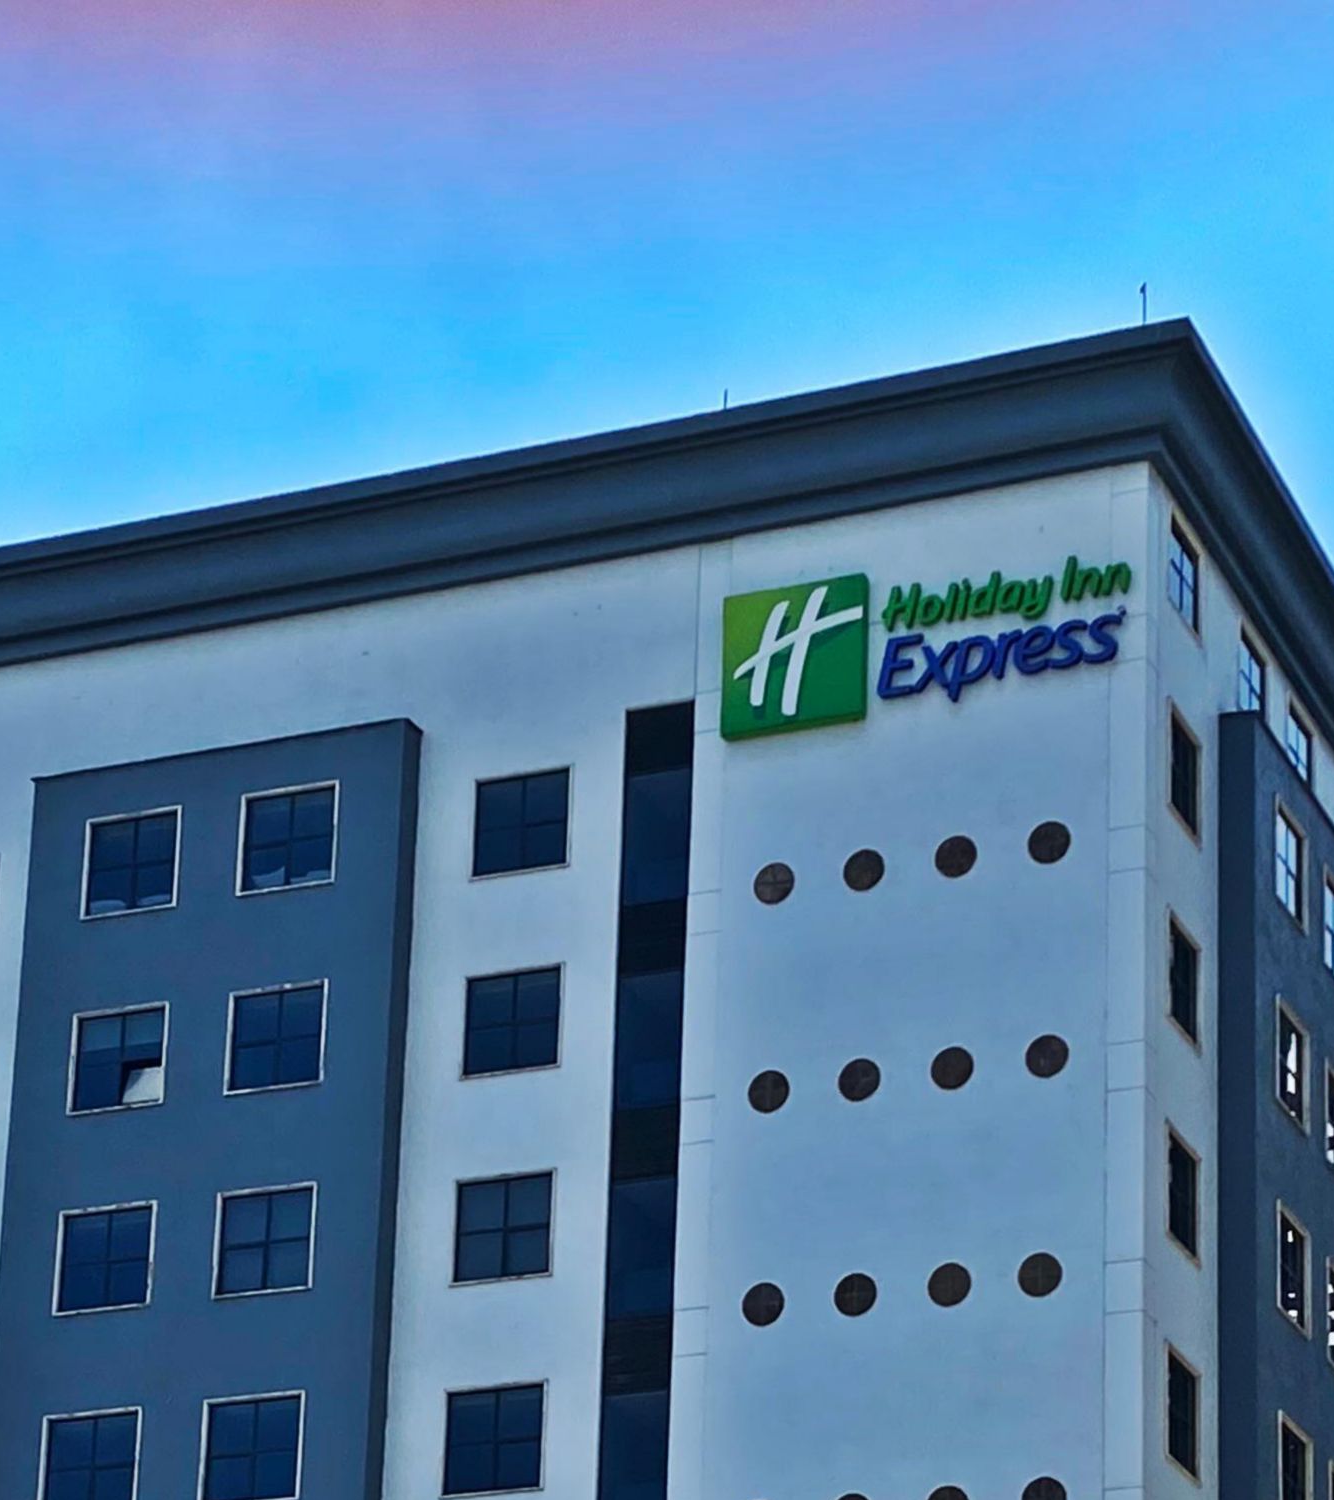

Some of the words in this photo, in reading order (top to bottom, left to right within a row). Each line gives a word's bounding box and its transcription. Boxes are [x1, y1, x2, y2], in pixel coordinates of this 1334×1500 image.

[881, 571, 1054, 633] Holiday
[1061, 555, 1132, 604] Inn
[877, 612, 1123, 702] Express
